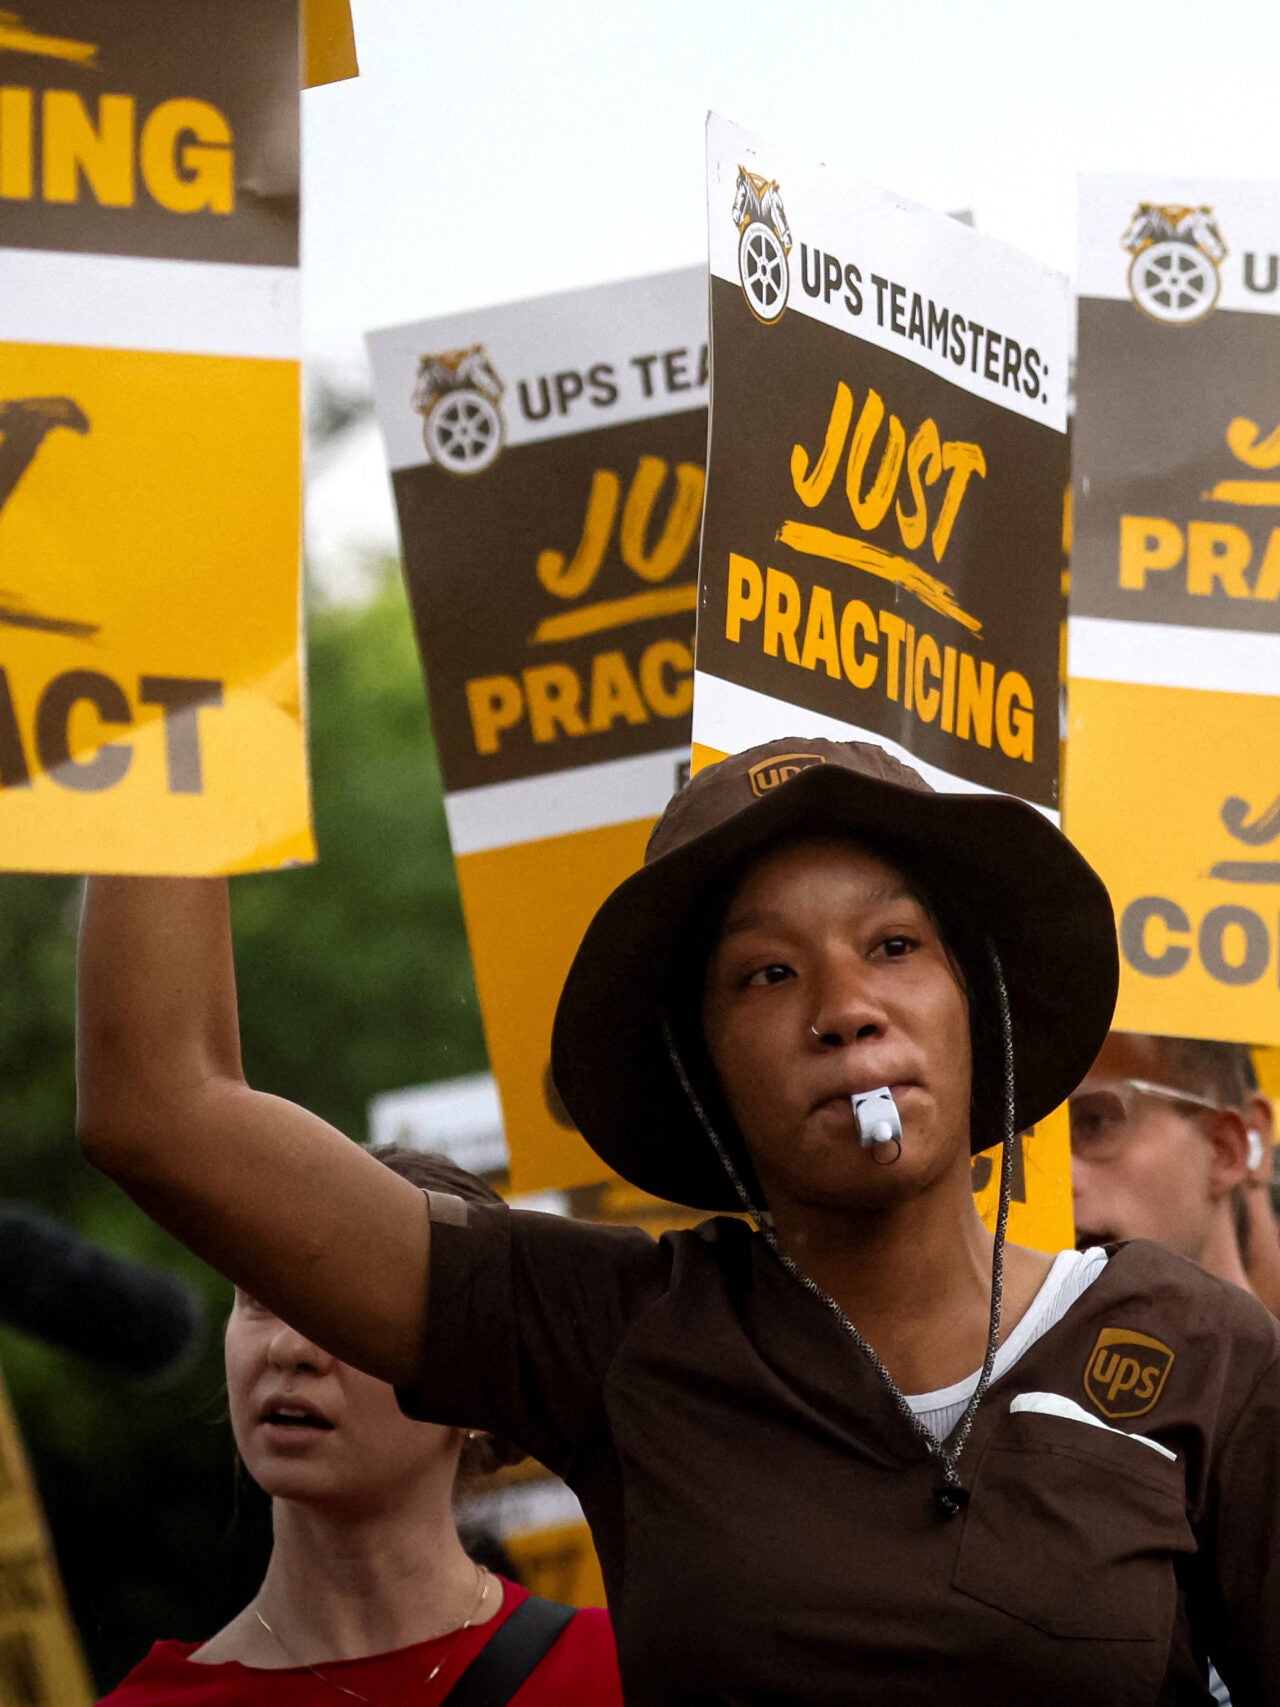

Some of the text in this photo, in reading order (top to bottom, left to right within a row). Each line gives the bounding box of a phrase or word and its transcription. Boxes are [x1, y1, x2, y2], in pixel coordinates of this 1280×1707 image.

[518, 363, 618, 422] UPS
[801, 243, 863, 316] UPS
[870, 272, 1048, 404] TEAMSTERS:
[790, 381, 986, 563] JUST
[726, 552, 1034, 763] PRACTICING
[1093, 1349, 1160, 1400] ups
